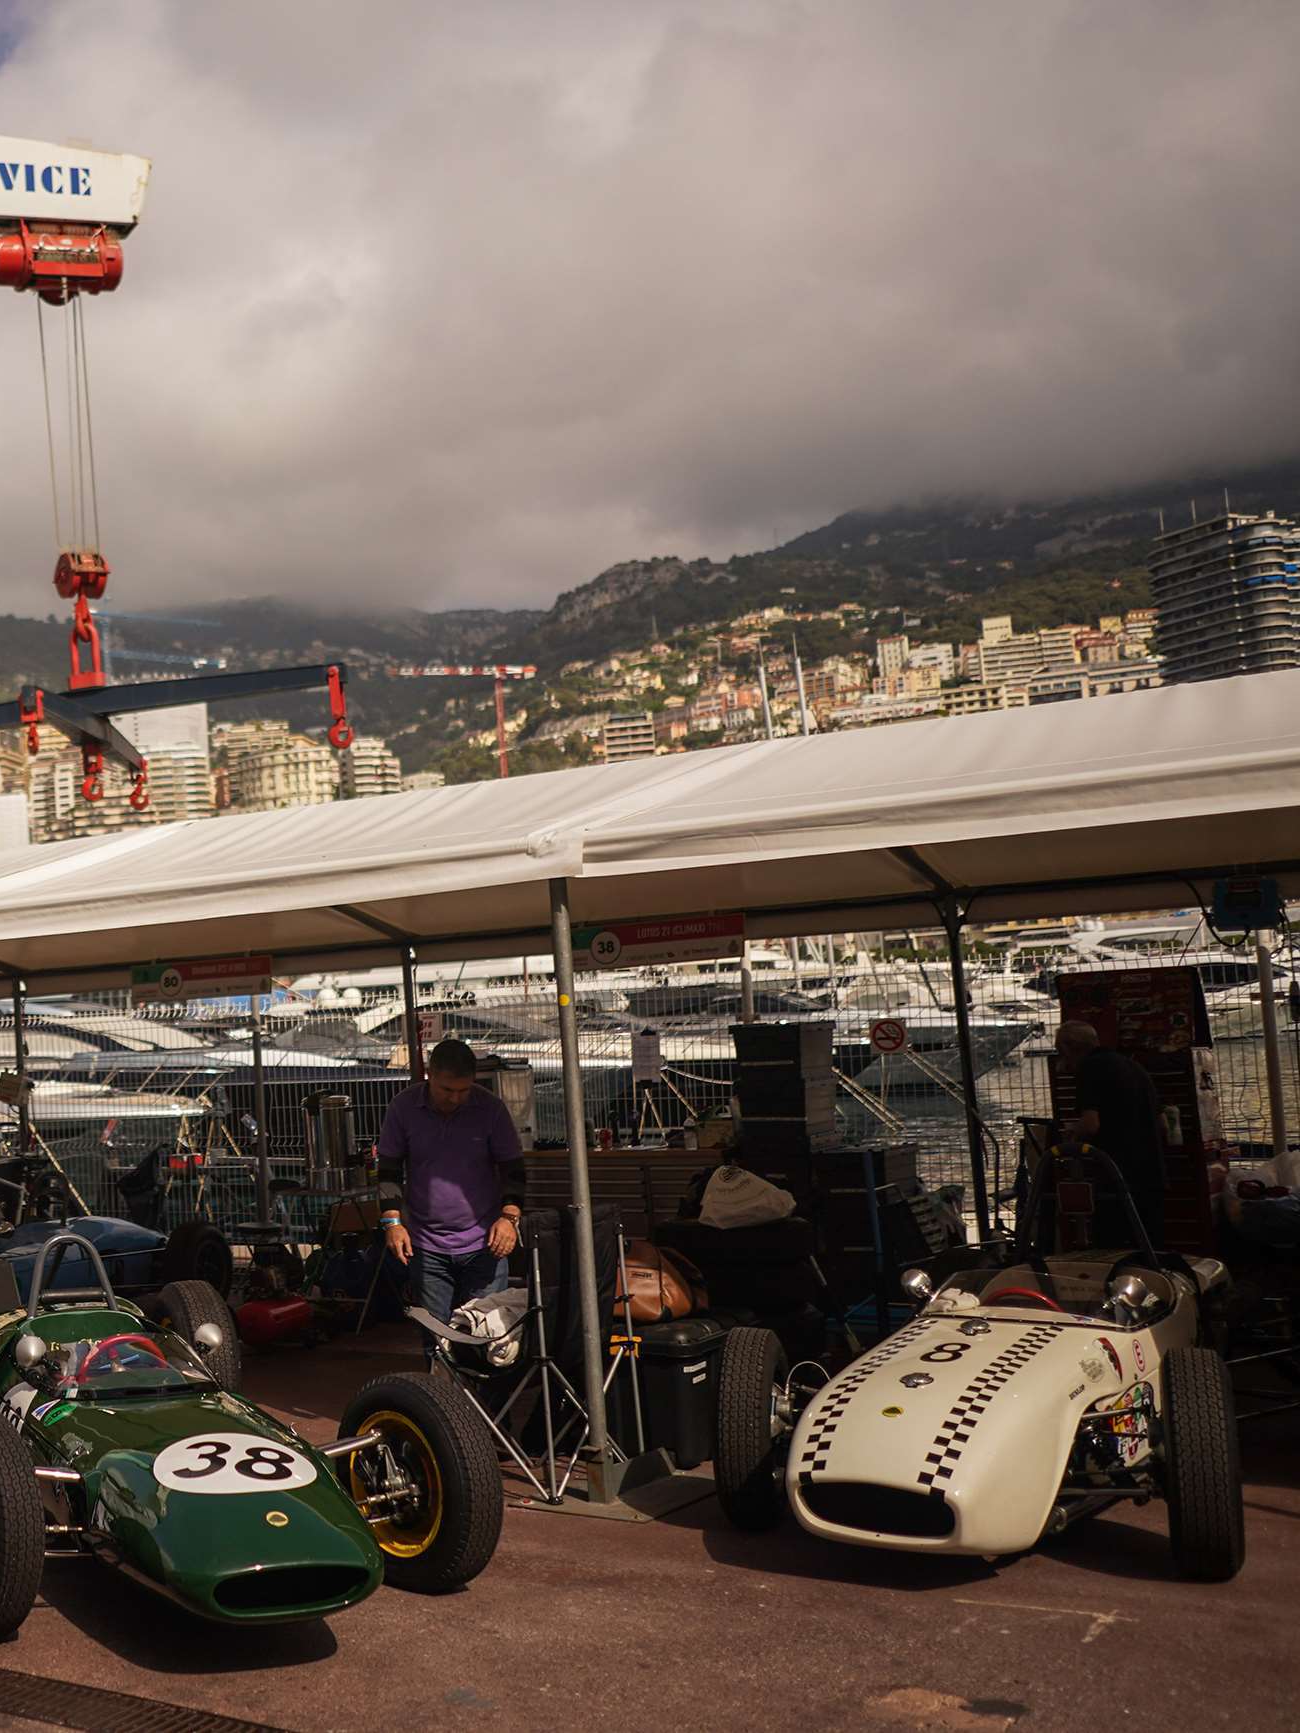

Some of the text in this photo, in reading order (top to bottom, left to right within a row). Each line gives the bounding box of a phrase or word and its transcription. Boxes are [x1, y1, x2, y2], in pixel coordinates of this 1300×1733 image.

[597, 940, 614, 954] 38
[163, 976, 178, 988] 80
[920, 1343, 971, 1363] 8
[172, 1440, 296, 1482] 38
